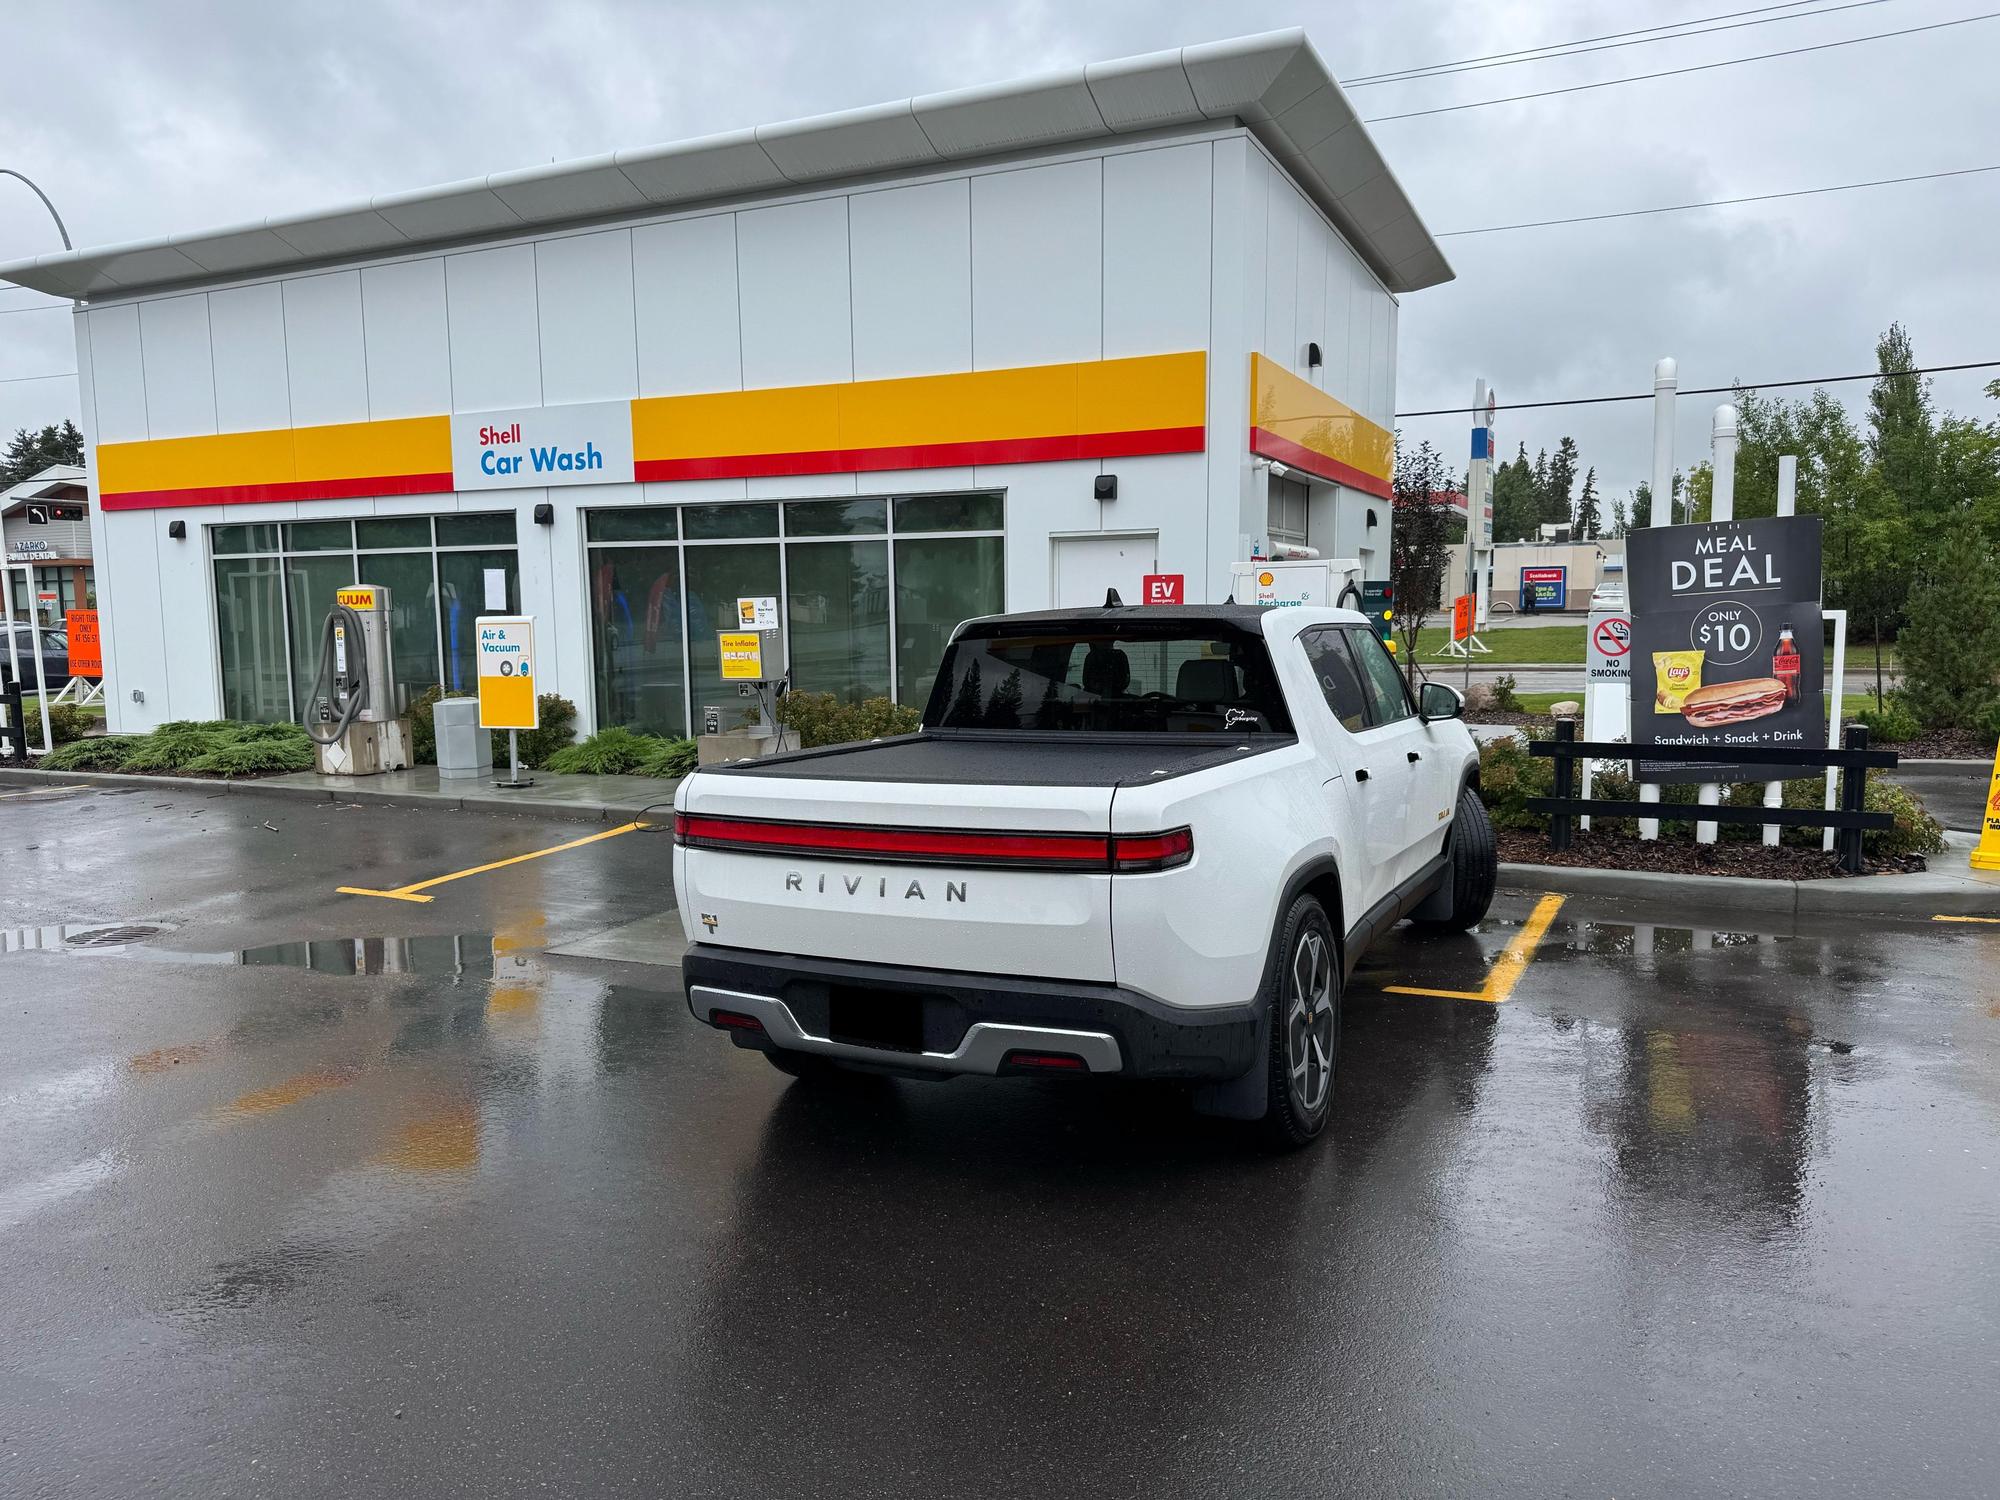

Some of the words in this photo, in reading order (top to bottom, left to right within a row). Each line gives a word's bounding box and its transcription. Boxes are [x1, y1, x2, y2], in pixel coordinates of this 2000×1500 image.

[479, 424, 521, 446] Shell
[481, 450, 523, 475] Car
[530, 442, 602, 472] Wash
[14, 541, 47, 551] AZARKO
[1695, 534, 1757, 555] MEAL
[1671, 554, 1781, 590] DEAL
[1151, 582, 1175, 598] EV
[338, 594, 372, 605] CUUM
[1708, 610, 1742, 622] ONLY
[481, 630, 496, 640] Air
[498, 630, 506, 640] &
[1699, 623, 1751, 652] $10
[482, 643, 521, 653] Vacuum
[1606, 659, 1620, 667] NO
[1654, 734, 1709, 746] Sandwich
[1724, 732, 1759, 744] Snack
[1773, 729, 1803, 741] Drink
[785, 870, 967, 903] RIVIAN
